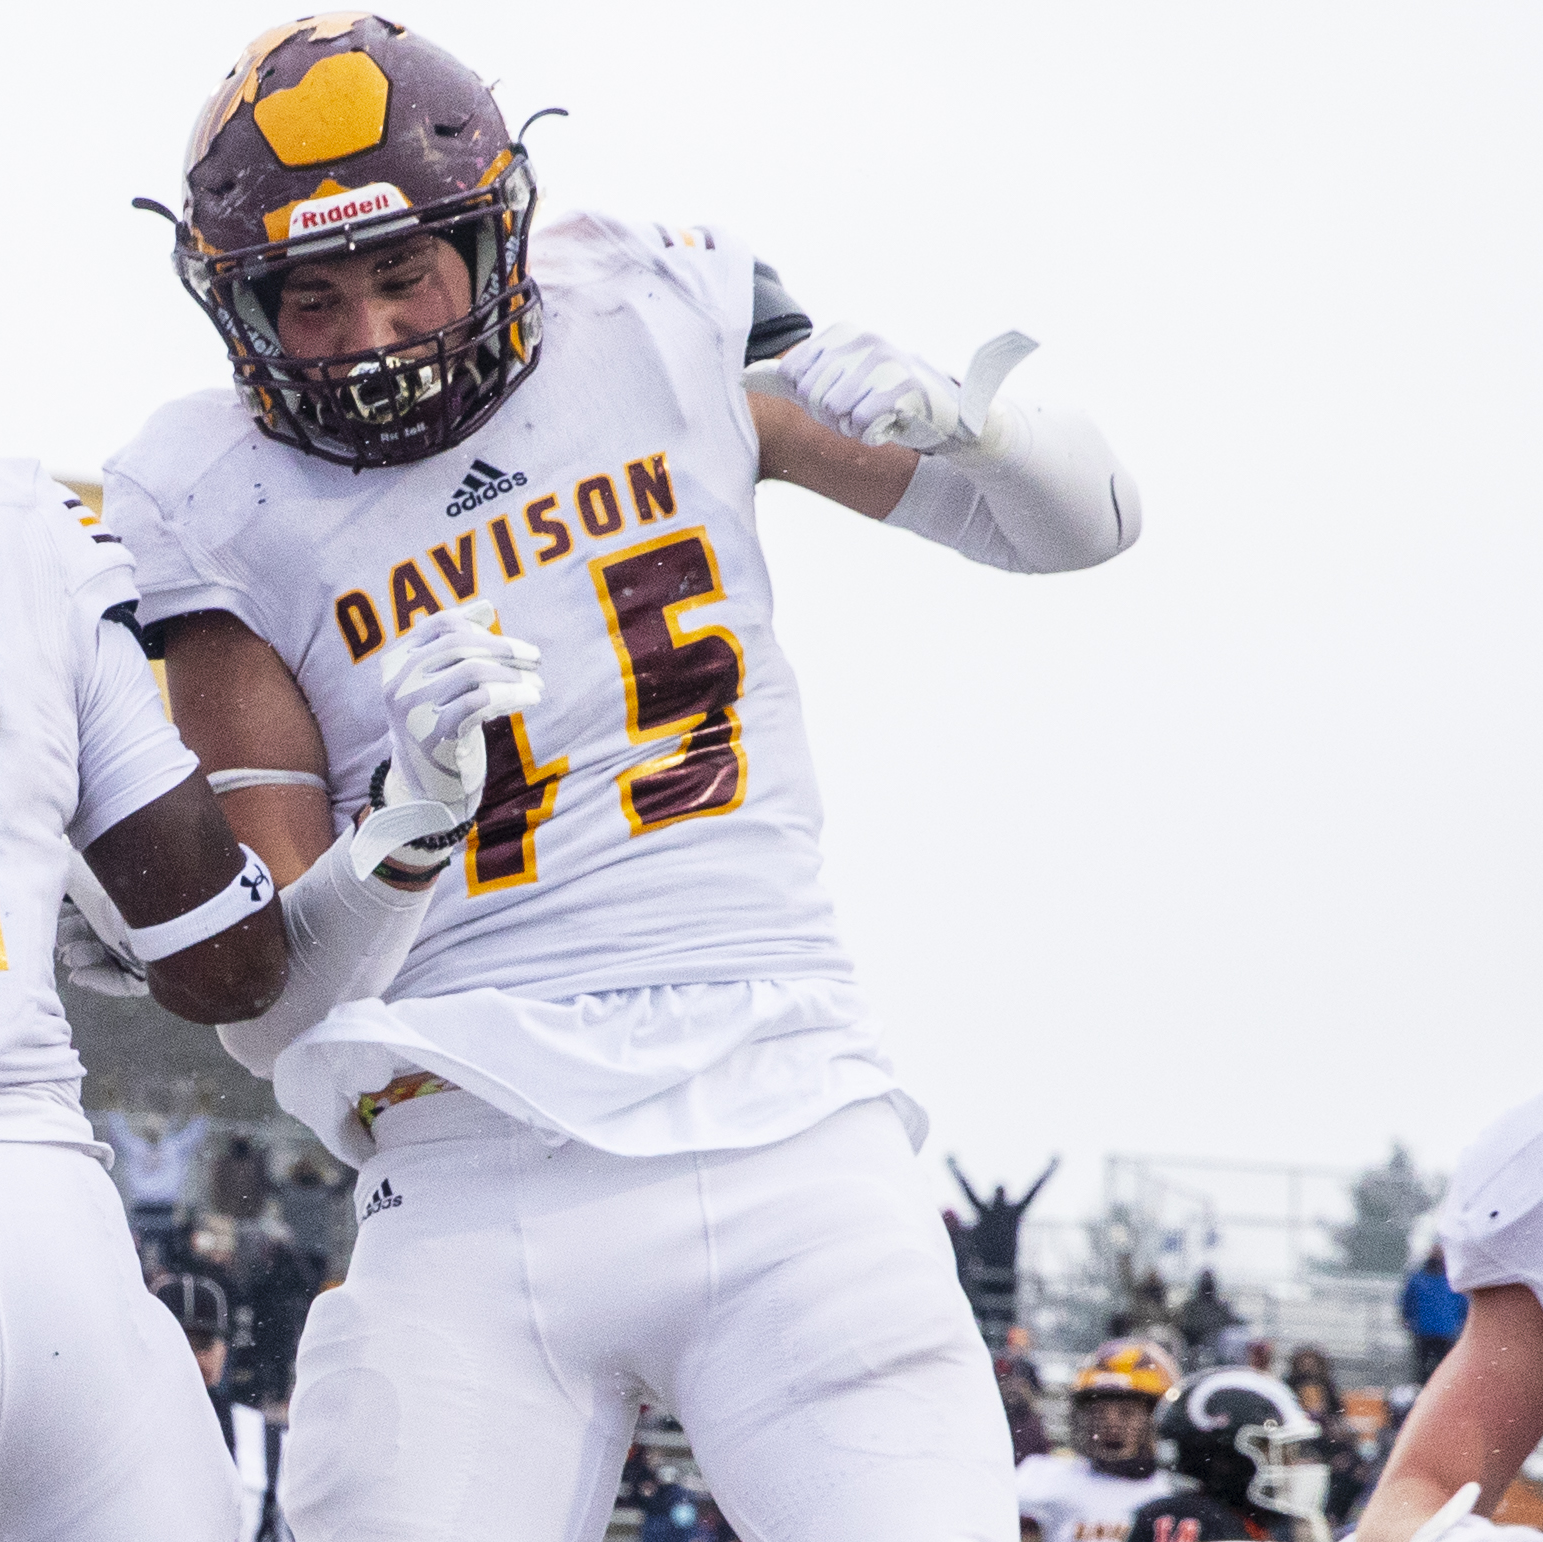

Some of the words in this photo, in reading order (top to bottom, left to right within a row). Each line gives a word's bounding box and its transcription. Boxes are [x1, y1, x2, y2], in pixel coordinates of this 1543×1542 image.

[300, 193, 390, 230] Riddell
[445, 468, 528, 518] adidas
[334, 451, 678, 665] DAVISON
